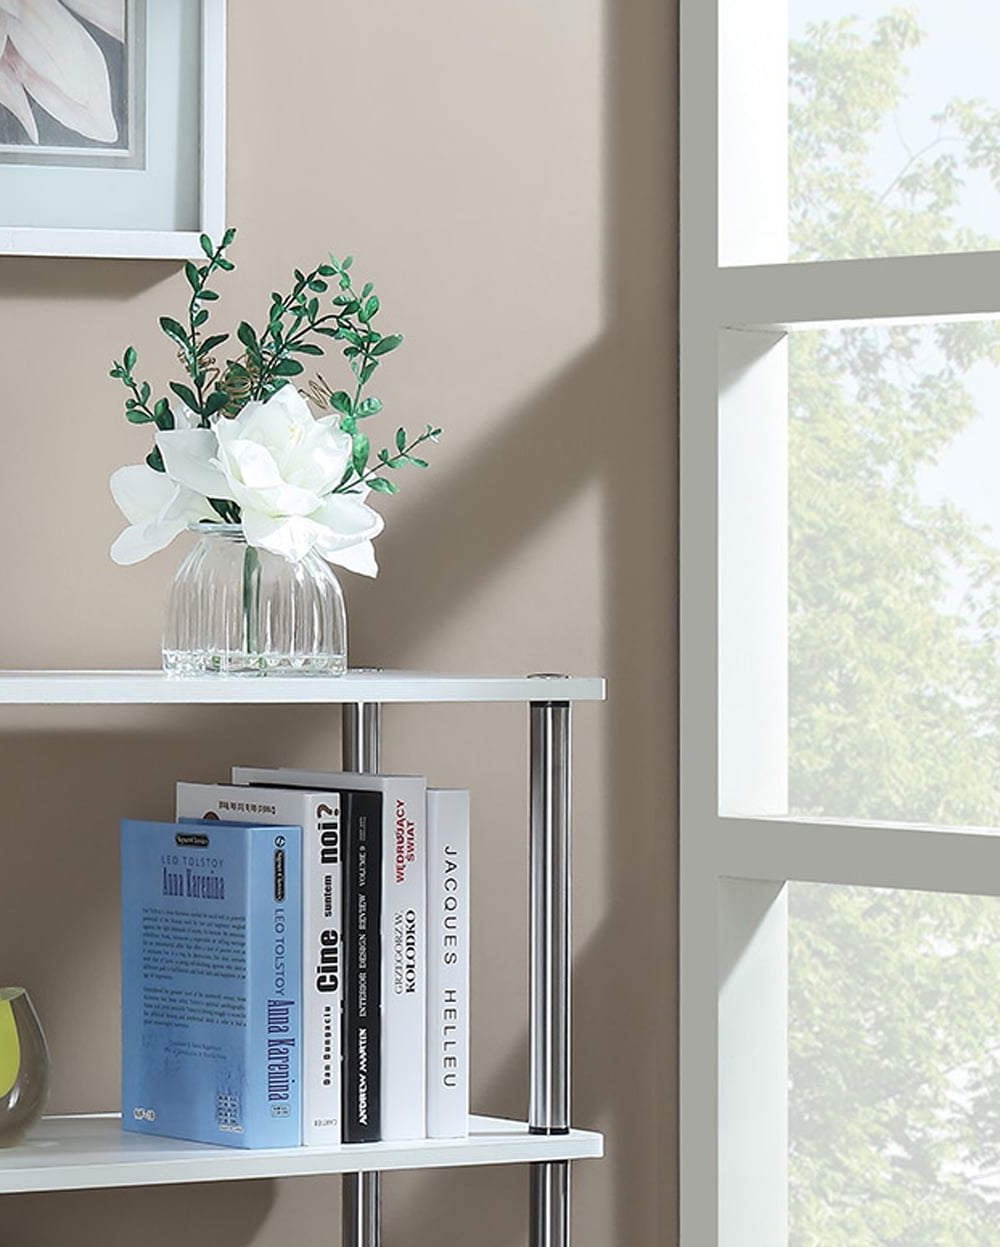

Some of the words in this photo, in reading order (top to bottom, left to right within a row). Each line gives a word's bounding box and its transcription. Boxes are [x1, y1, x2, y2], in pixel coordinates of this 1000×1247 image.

[161, 855, 179, 866] LEO
[182, 856, 224, 868] TOLSTOY
[162, 867, 184, 897] Anna
[186, 868, 225, 900] Karenina
[323, 874, 333, 917] suntem
[274, 908, 286, 933] LEO
[358, 892, 367, 930] REVIEW
[444, 846, 457, 965] JACQUES
[274, 937, 287, 996] TOLSTOY
[316, 930, 339, 993] Cine
[358, 933, 367, 969] DESIGN
[267, 999, 296, 1034] Anna
[358, 973, 367, 1017] INTERIOR
[358, 1028, 368, 1073] MARTIN
[443, 989, 457, 1088] HELLEU
[267, 1038, 296, 1101] Karenina
[323, 1064, 332, 1085] Dan
